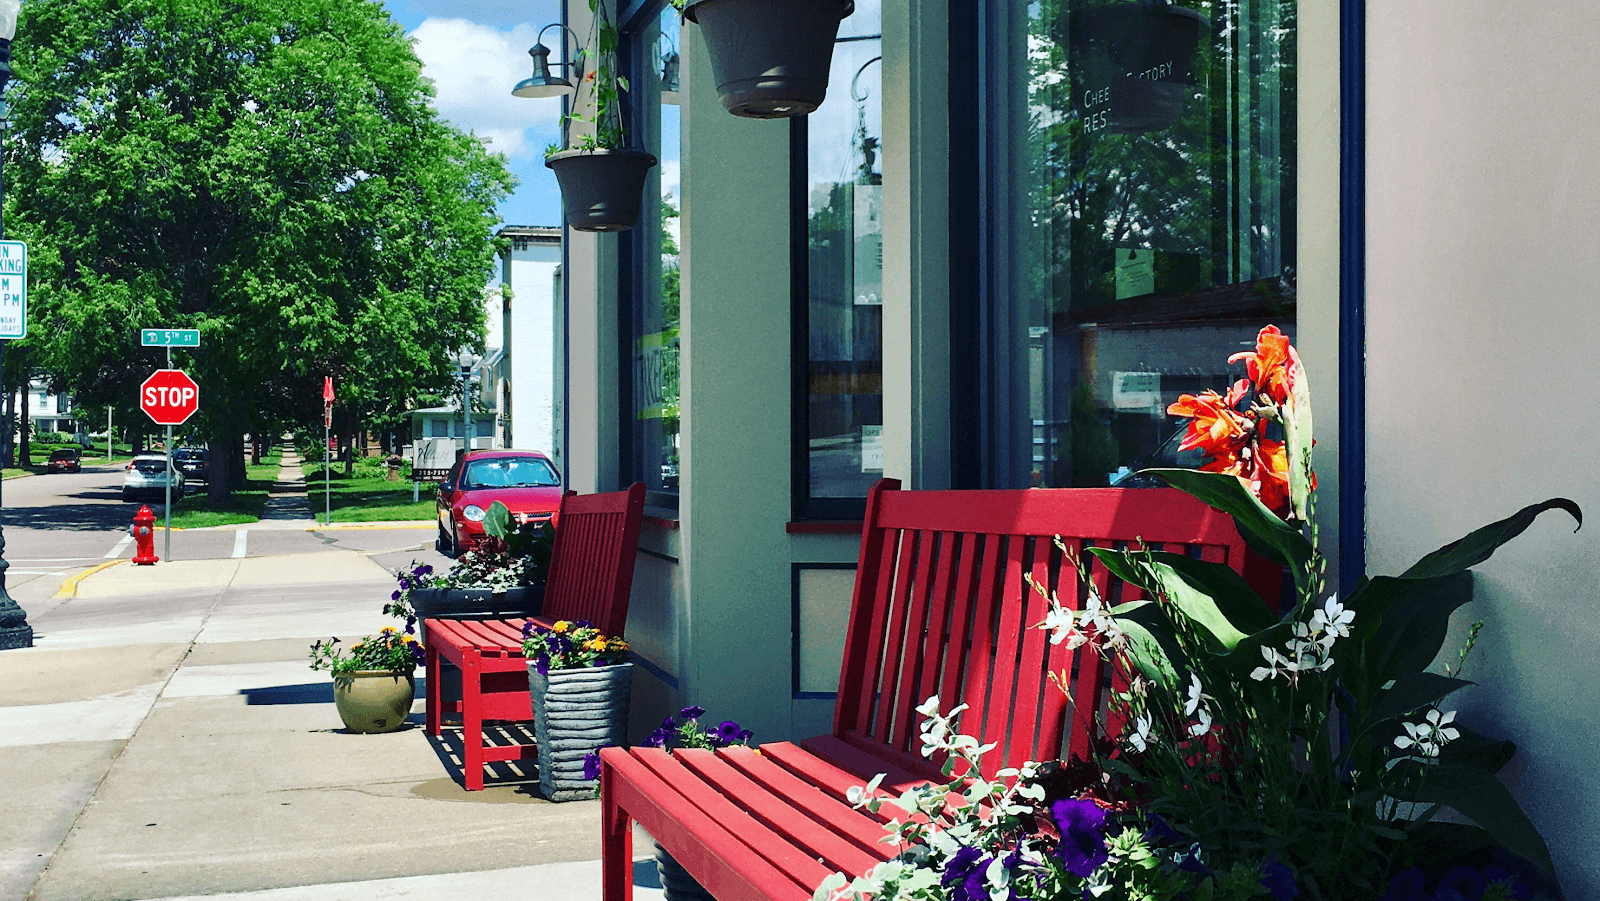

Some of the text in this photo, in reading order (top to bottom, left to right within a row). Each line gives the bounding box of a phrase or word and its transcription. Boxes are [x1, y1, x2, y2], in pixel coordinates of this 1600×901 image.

[1083, 108, 1111, 134] RES
[4, 293, 19, 307] PM
[165, 332, 179, 344] 5TH
[145, 387, 195, 408] STOP
